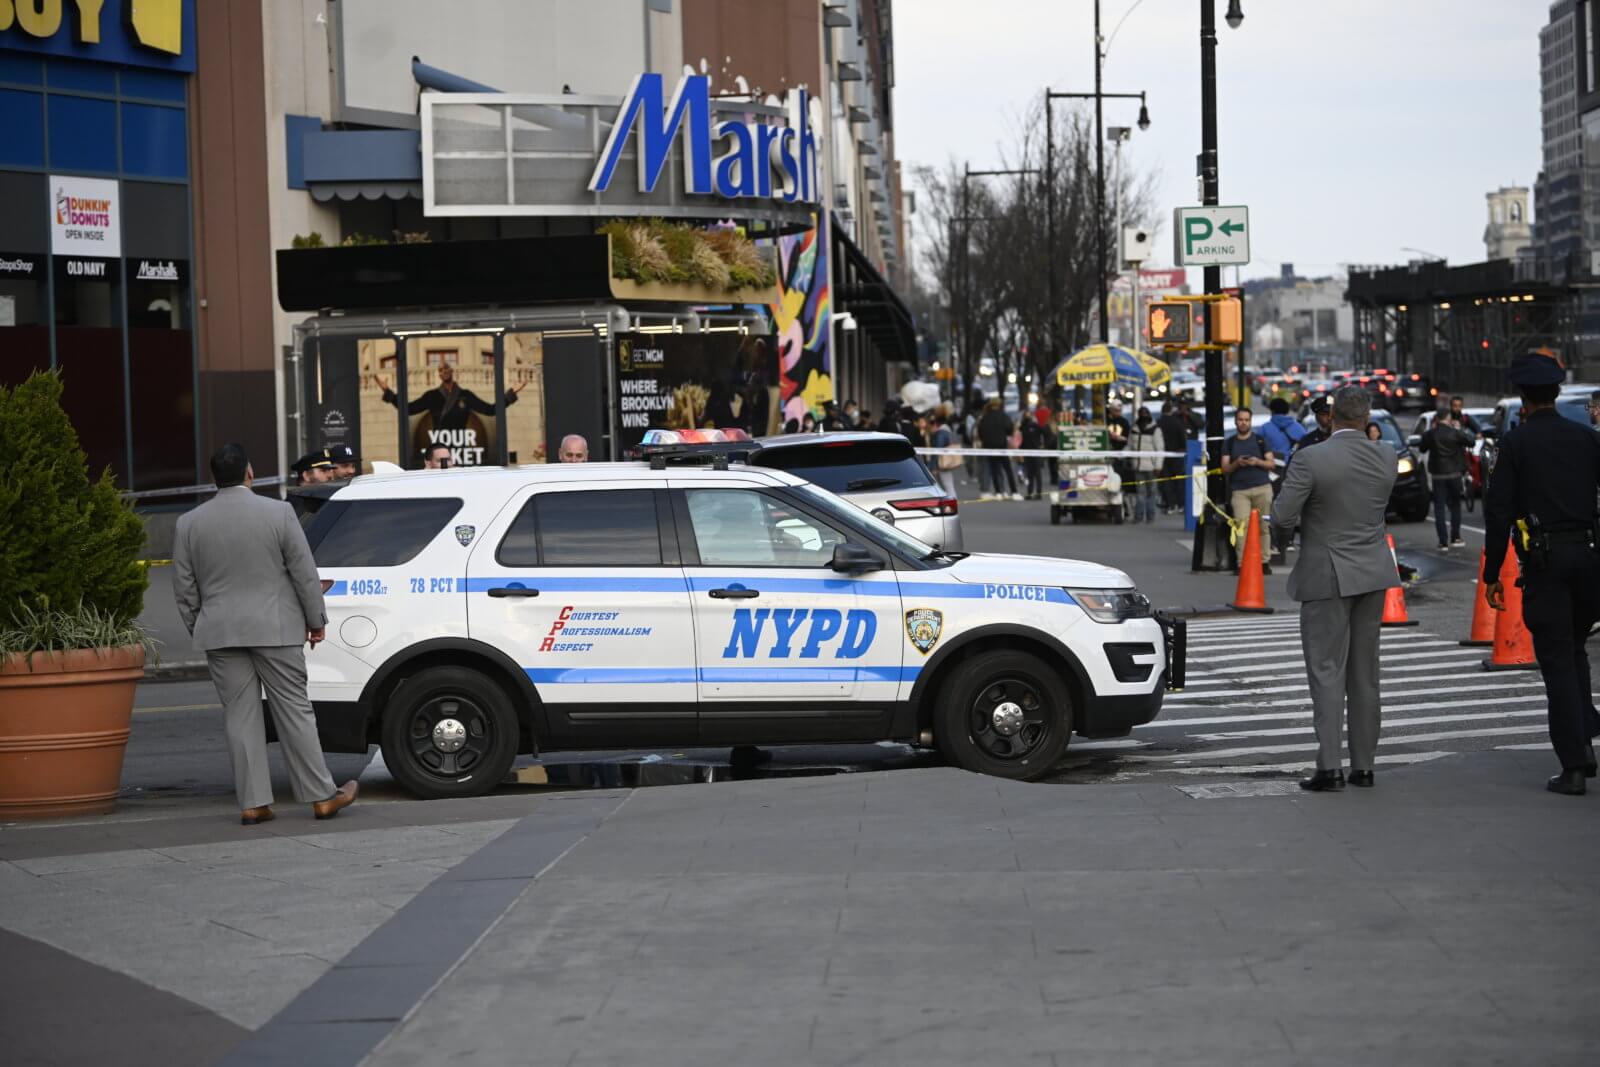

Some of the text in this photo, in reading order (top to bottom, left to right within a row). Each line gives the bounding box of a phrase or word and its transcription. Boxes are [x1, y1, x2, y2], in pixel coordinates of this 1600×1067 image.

[71, 212, 110, 227] DONUTS
[65, 229, 105, 241] OPEN INSIDE
[67, 261, 106, 276] OLD NAVY
[136, 261, 179, 278] Marshalls
[620, 379, 658, 394] WHERE
[621, 396, 675, 410] BROOKLYN
[622, 413, 649, 428] WINS
[427, 429, 477, 447] YOUR
[350, 579, 381, 595] 4052
[410, 577, 454, 593] 78 PCT
[986, 583, 1044, 602] POLICE
[722, 608, 878, 659] NYPD
